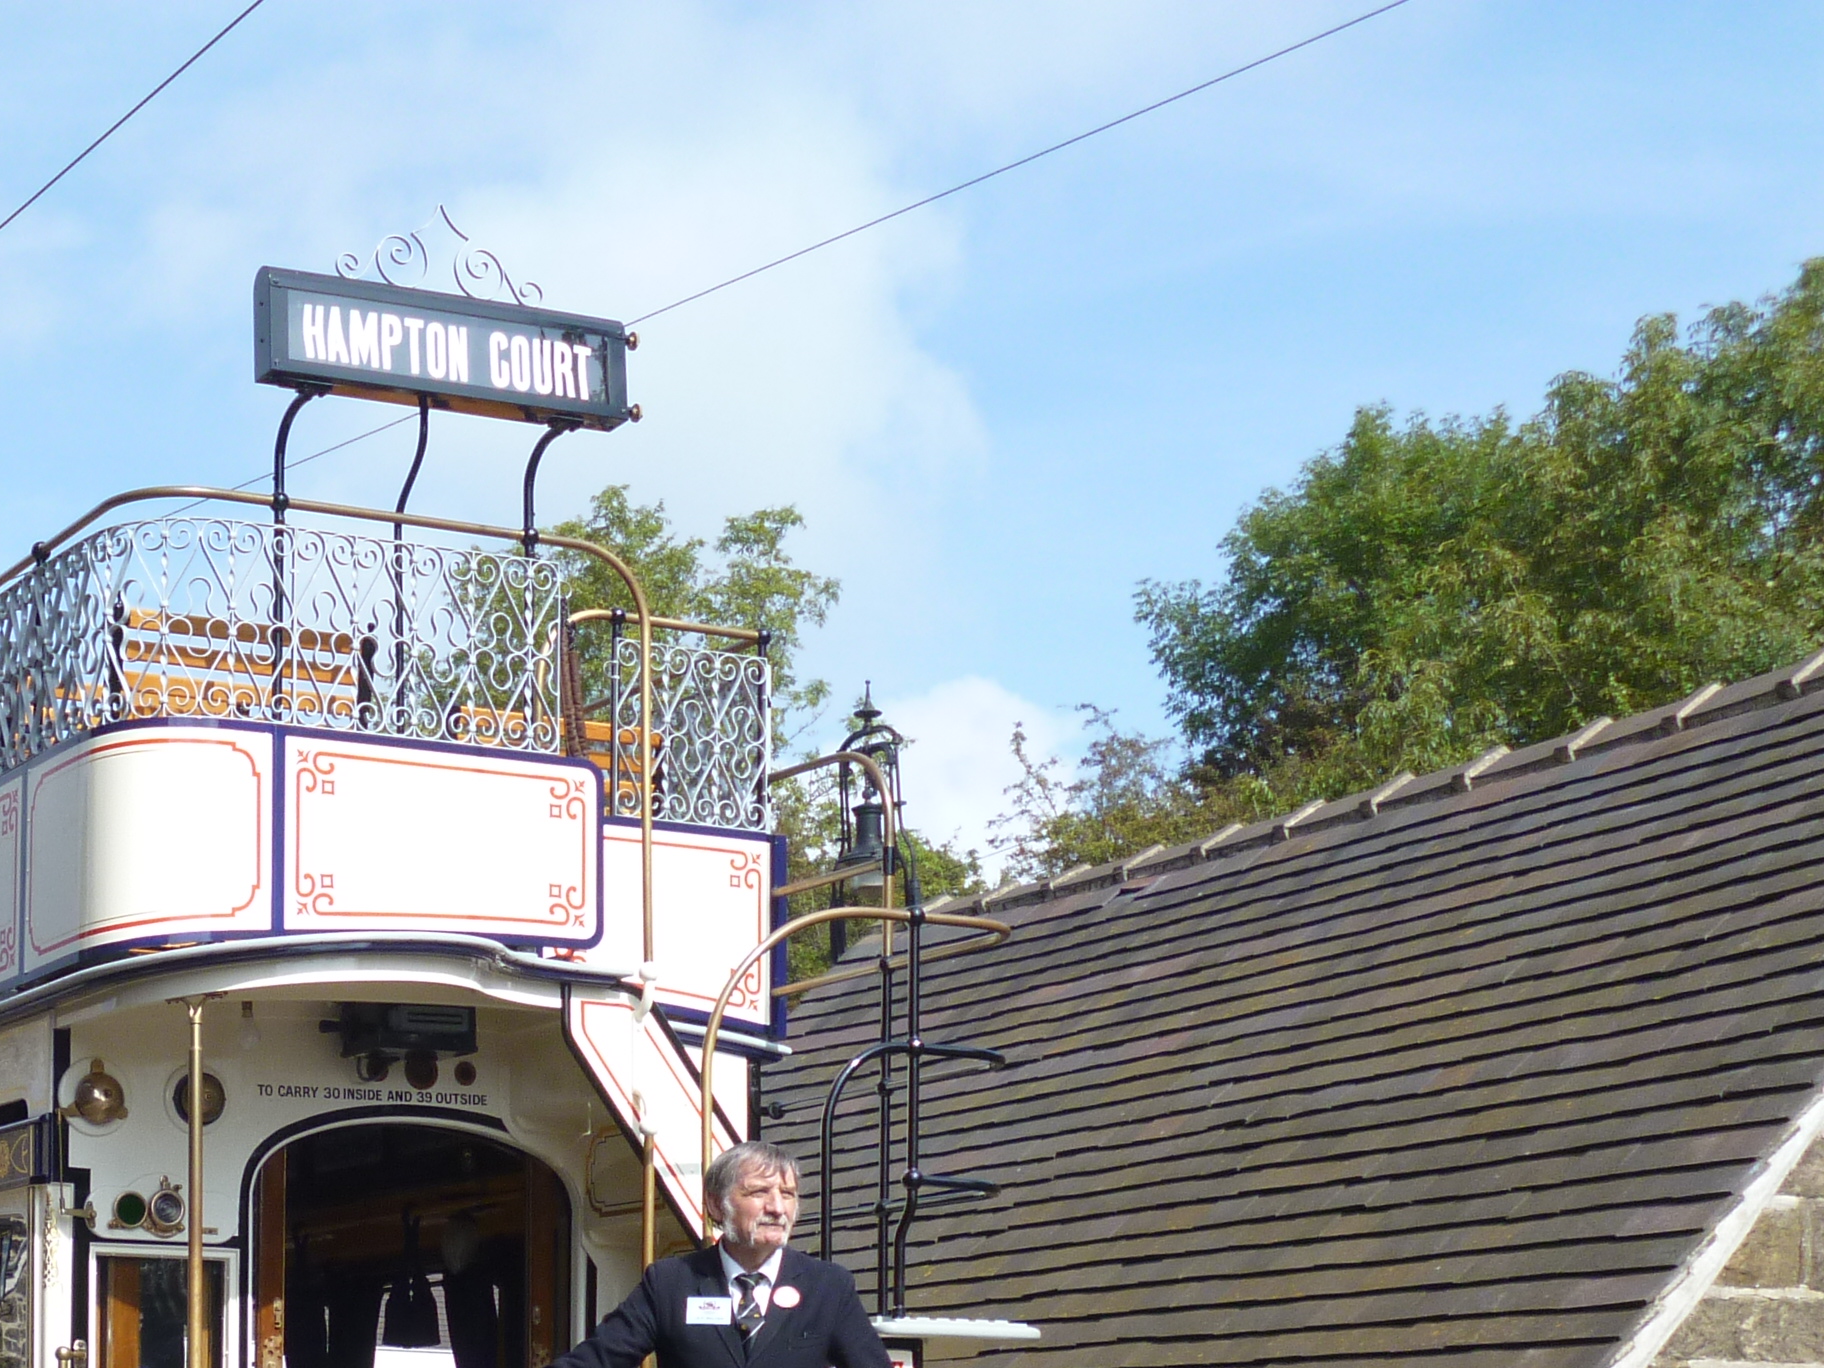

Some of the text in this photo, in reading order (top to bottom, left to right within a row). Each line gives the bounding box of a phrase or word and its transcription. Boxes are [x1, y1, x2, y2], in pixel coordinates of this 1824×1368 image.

[303, 304, 592, 400] HAMPTON COURT
[257, 1084, 488, 1106] TO CARRY 30 INSIDE AND 39 OUTSIDE
